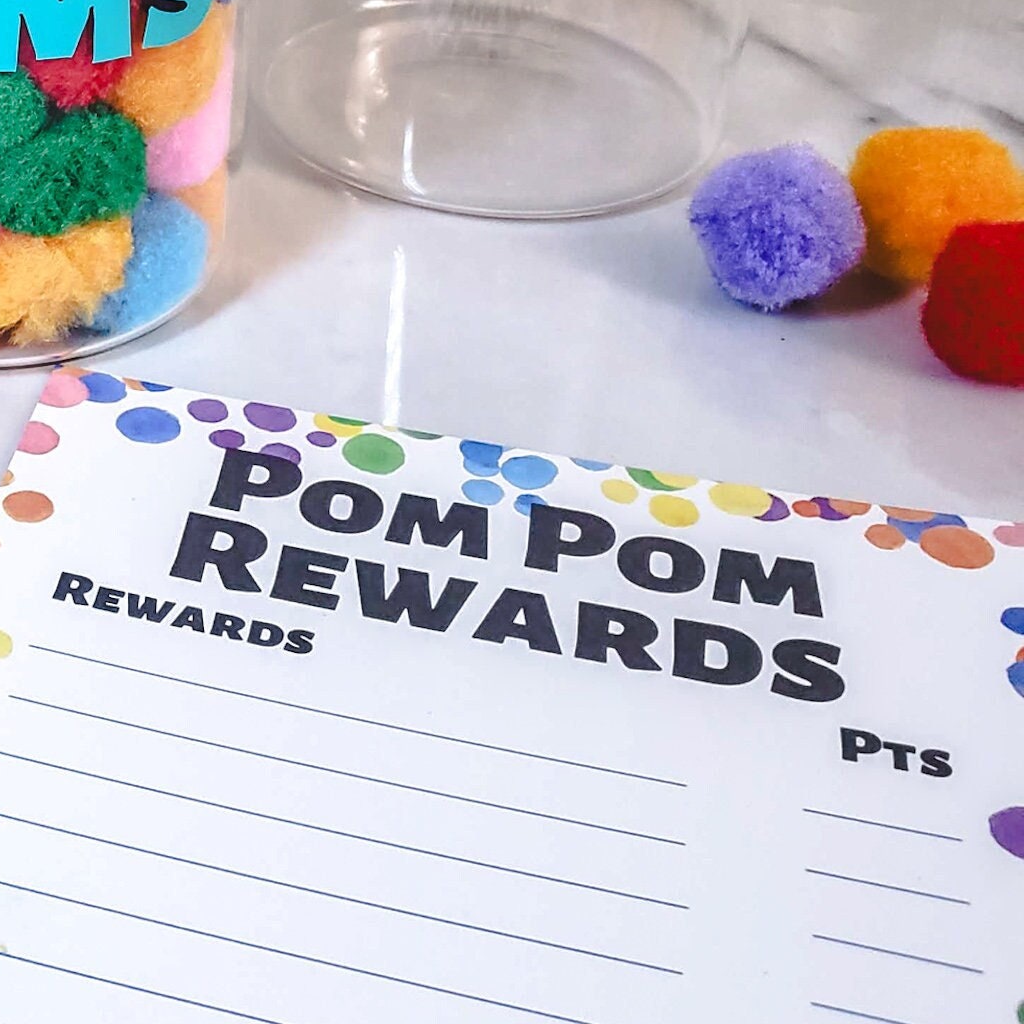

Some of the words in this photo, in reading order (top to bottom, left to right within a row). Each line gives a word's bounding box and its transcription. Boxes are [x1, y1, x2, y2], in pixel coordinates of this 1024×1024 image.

[208, 445, 489, 560] POM
[523, 504, 825, 618] POM
[51, 570, 316, 655] REWARDS
[169, 511, 846, 704] REWARDS
[839, 727, 954, 779] PTS
